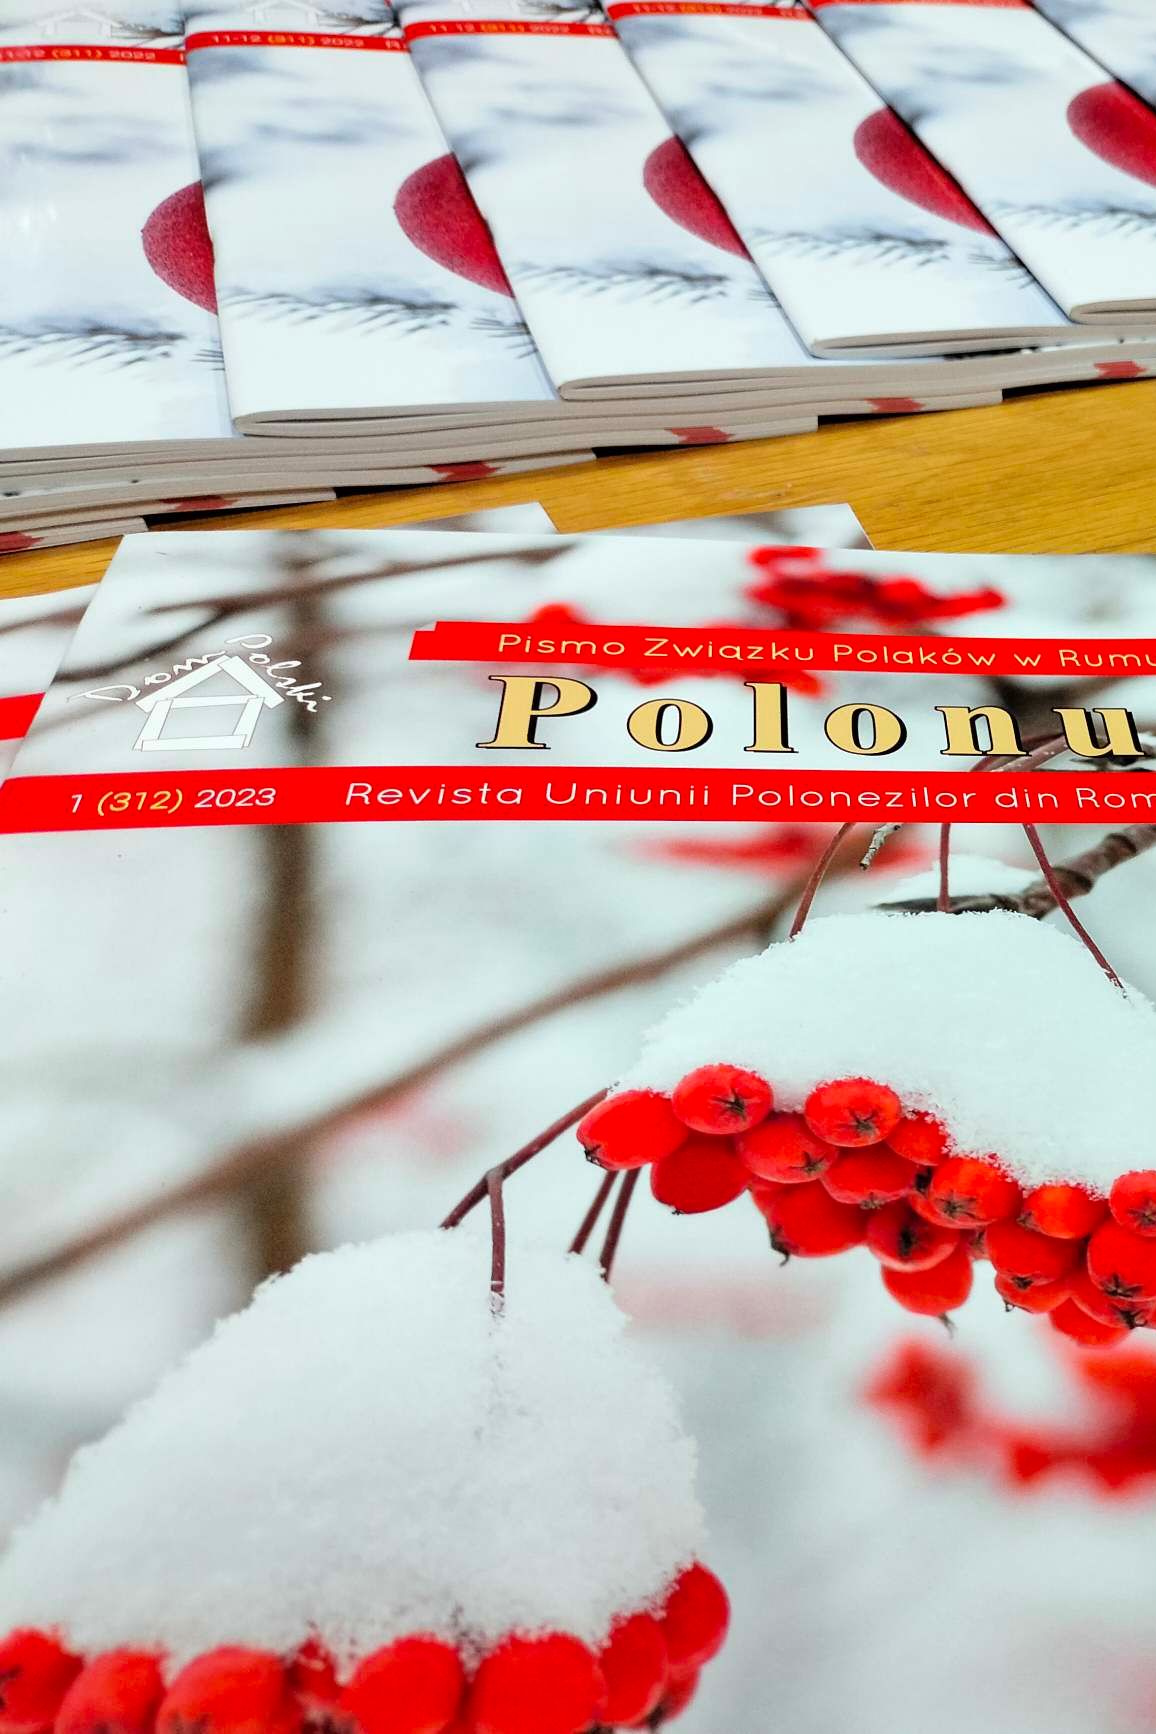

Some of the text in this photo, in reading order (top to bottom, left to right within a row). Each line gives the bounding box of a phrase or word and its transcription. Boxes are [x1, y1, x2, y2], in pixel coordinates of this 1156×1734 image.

[498, 633, 626, 656] Pismo
[643, 637, 815, 662] Związku
[832, 643, 997, 667] Polaków
[1013, 653, 1042, 668] w
[66, 633, 332, 713] Dom Polski
[70, 787, 277, 816] 1 (312) 2023
[345, 782, 523, 806] Revista
[545, 782, 710, 806] Uniunii
[731, 783, 977, 808] Polonezilor
[995, 787, 1059, 808] din
